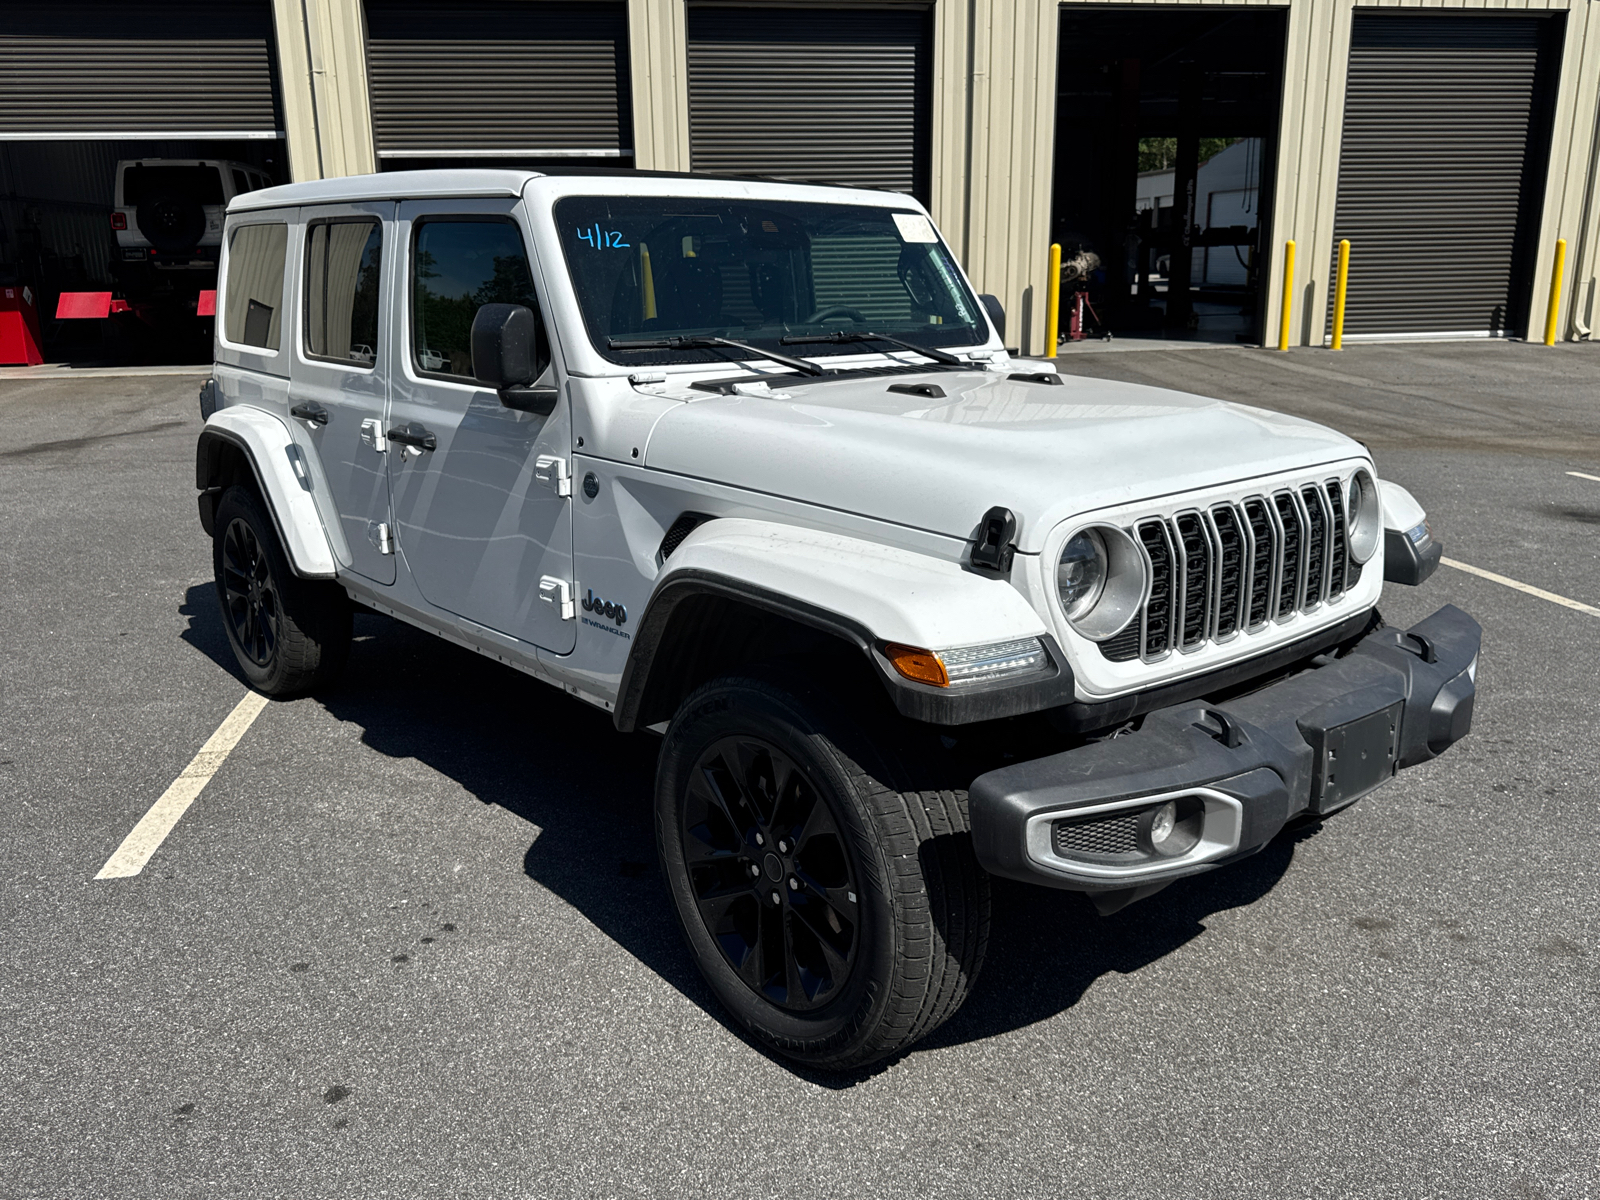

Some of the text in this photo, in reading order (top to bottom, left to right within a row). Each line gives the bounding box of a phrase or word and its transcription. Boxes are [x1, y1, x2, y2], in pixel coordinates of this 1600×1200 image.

[1183, 195, 1193, 235] Challenger
[577, 223, 631, 251] 4/12
[581, 588, 627, 626] Jeep
[588, 618, 631, 640] WRANGLER
[673, 698, 729, 743] NEXEN
